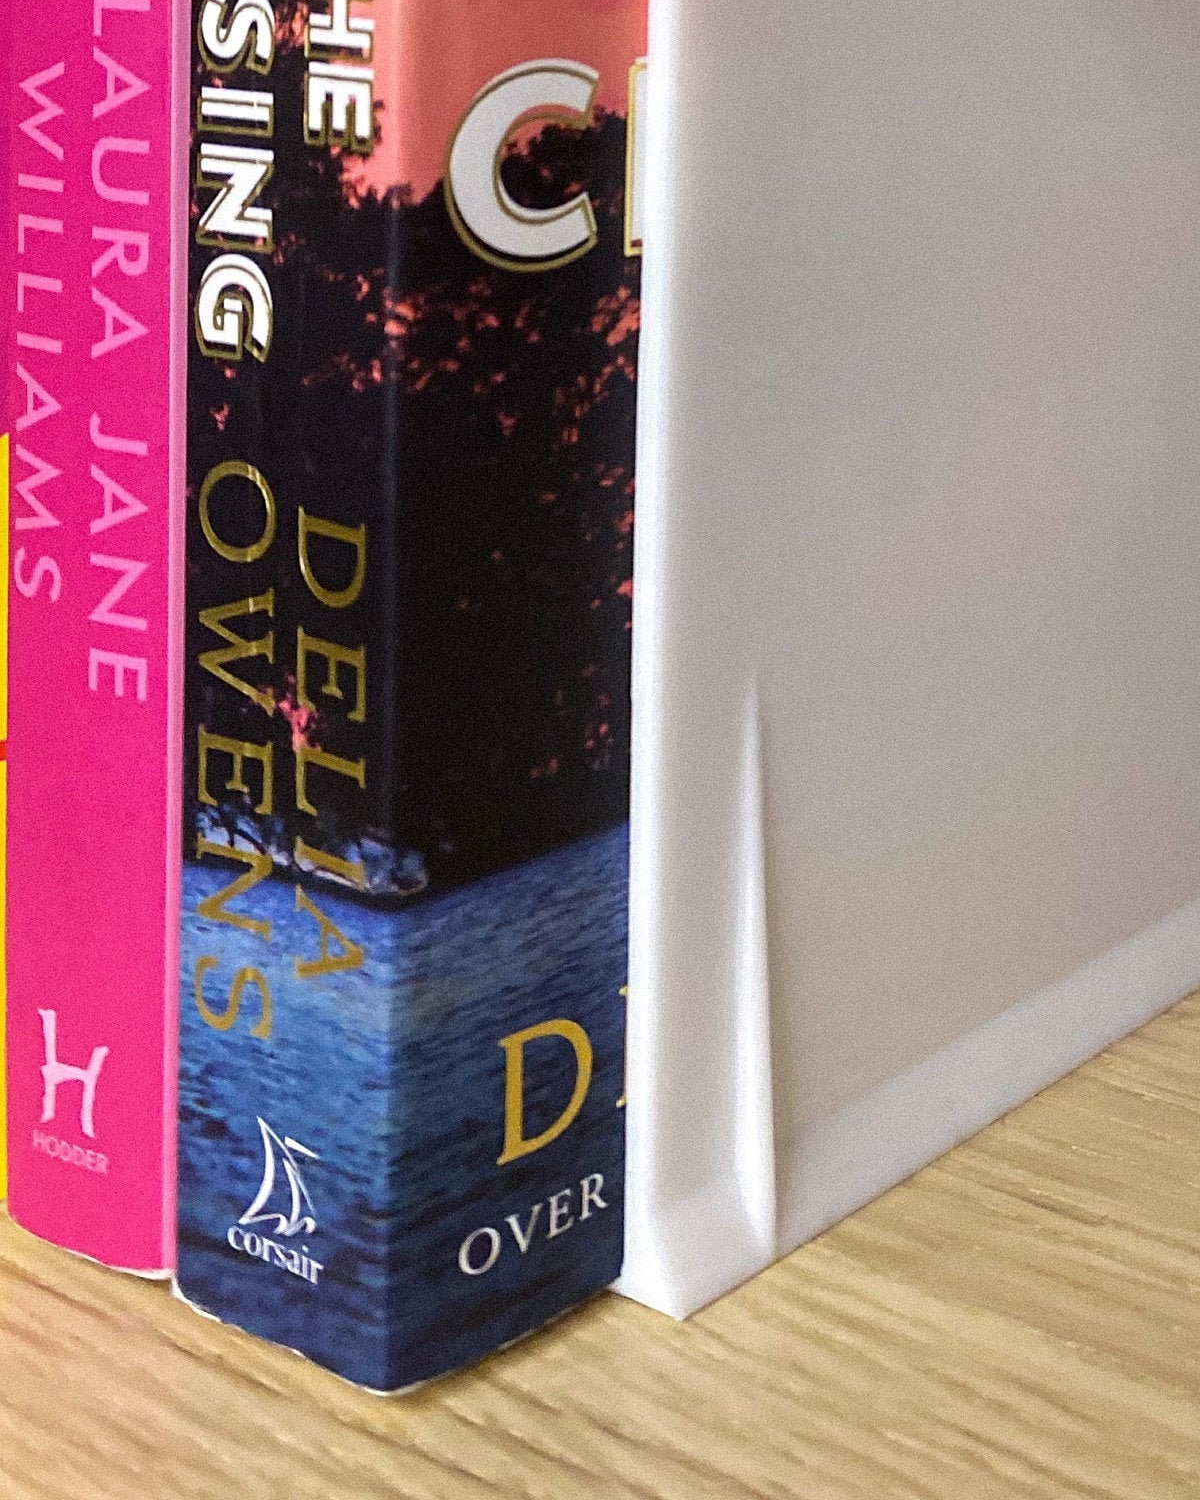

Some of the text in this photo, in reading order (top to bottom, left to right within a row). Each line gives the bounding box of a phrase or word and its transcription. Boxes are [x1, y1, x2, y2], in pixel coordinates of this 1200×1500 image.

[12, 60, 65, 603] WILLIAMS
[88, 411, 149, 700] JANE
[295, 505, 367, 978] DELIA
[195, 460, 276, 1040] OWENS
[227, 1225, 324, 1285] corsair
[458, 1173, 610, 1276] OVER
